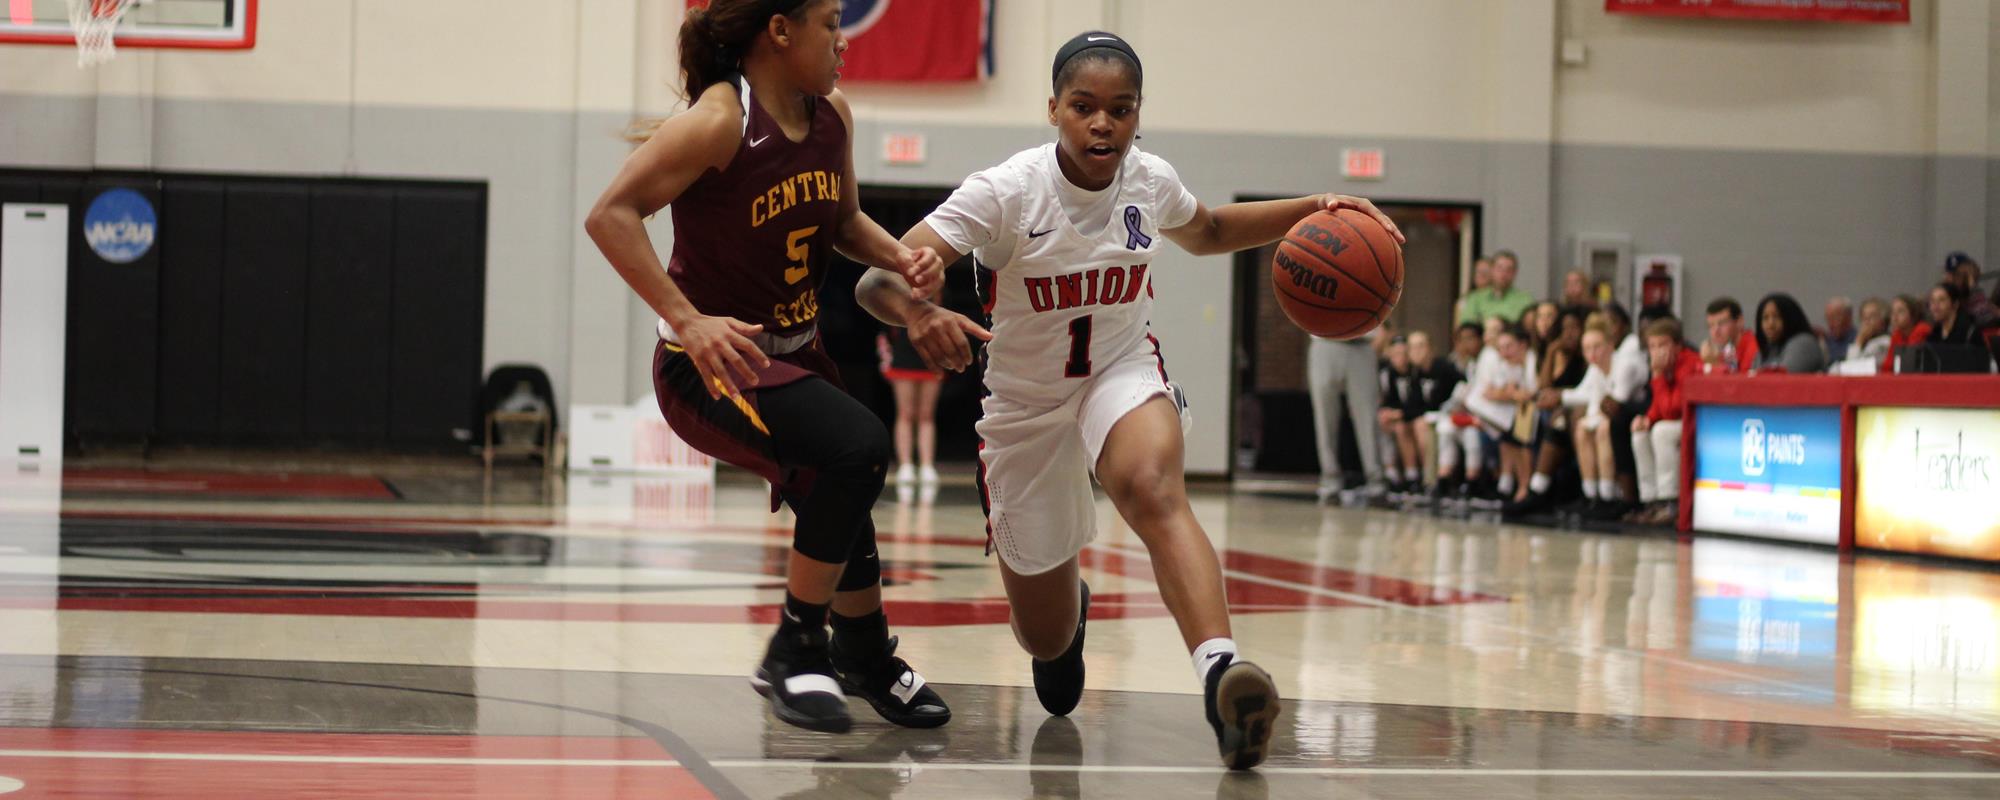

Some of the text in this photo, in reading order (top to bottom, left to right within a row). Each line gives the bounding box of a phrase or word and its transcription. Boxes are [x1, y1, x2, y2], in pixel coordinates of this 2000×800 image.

[85, 219, 155, 247] NCAA
[784, 225, 820, 286] 5
[1024, 263, 1148, 313] UNION
[1064, 313, 1093, 378] 1
[1767, 431, 1806, 465] PAINTS
[1914, 427, 1991, 491] Leaders
